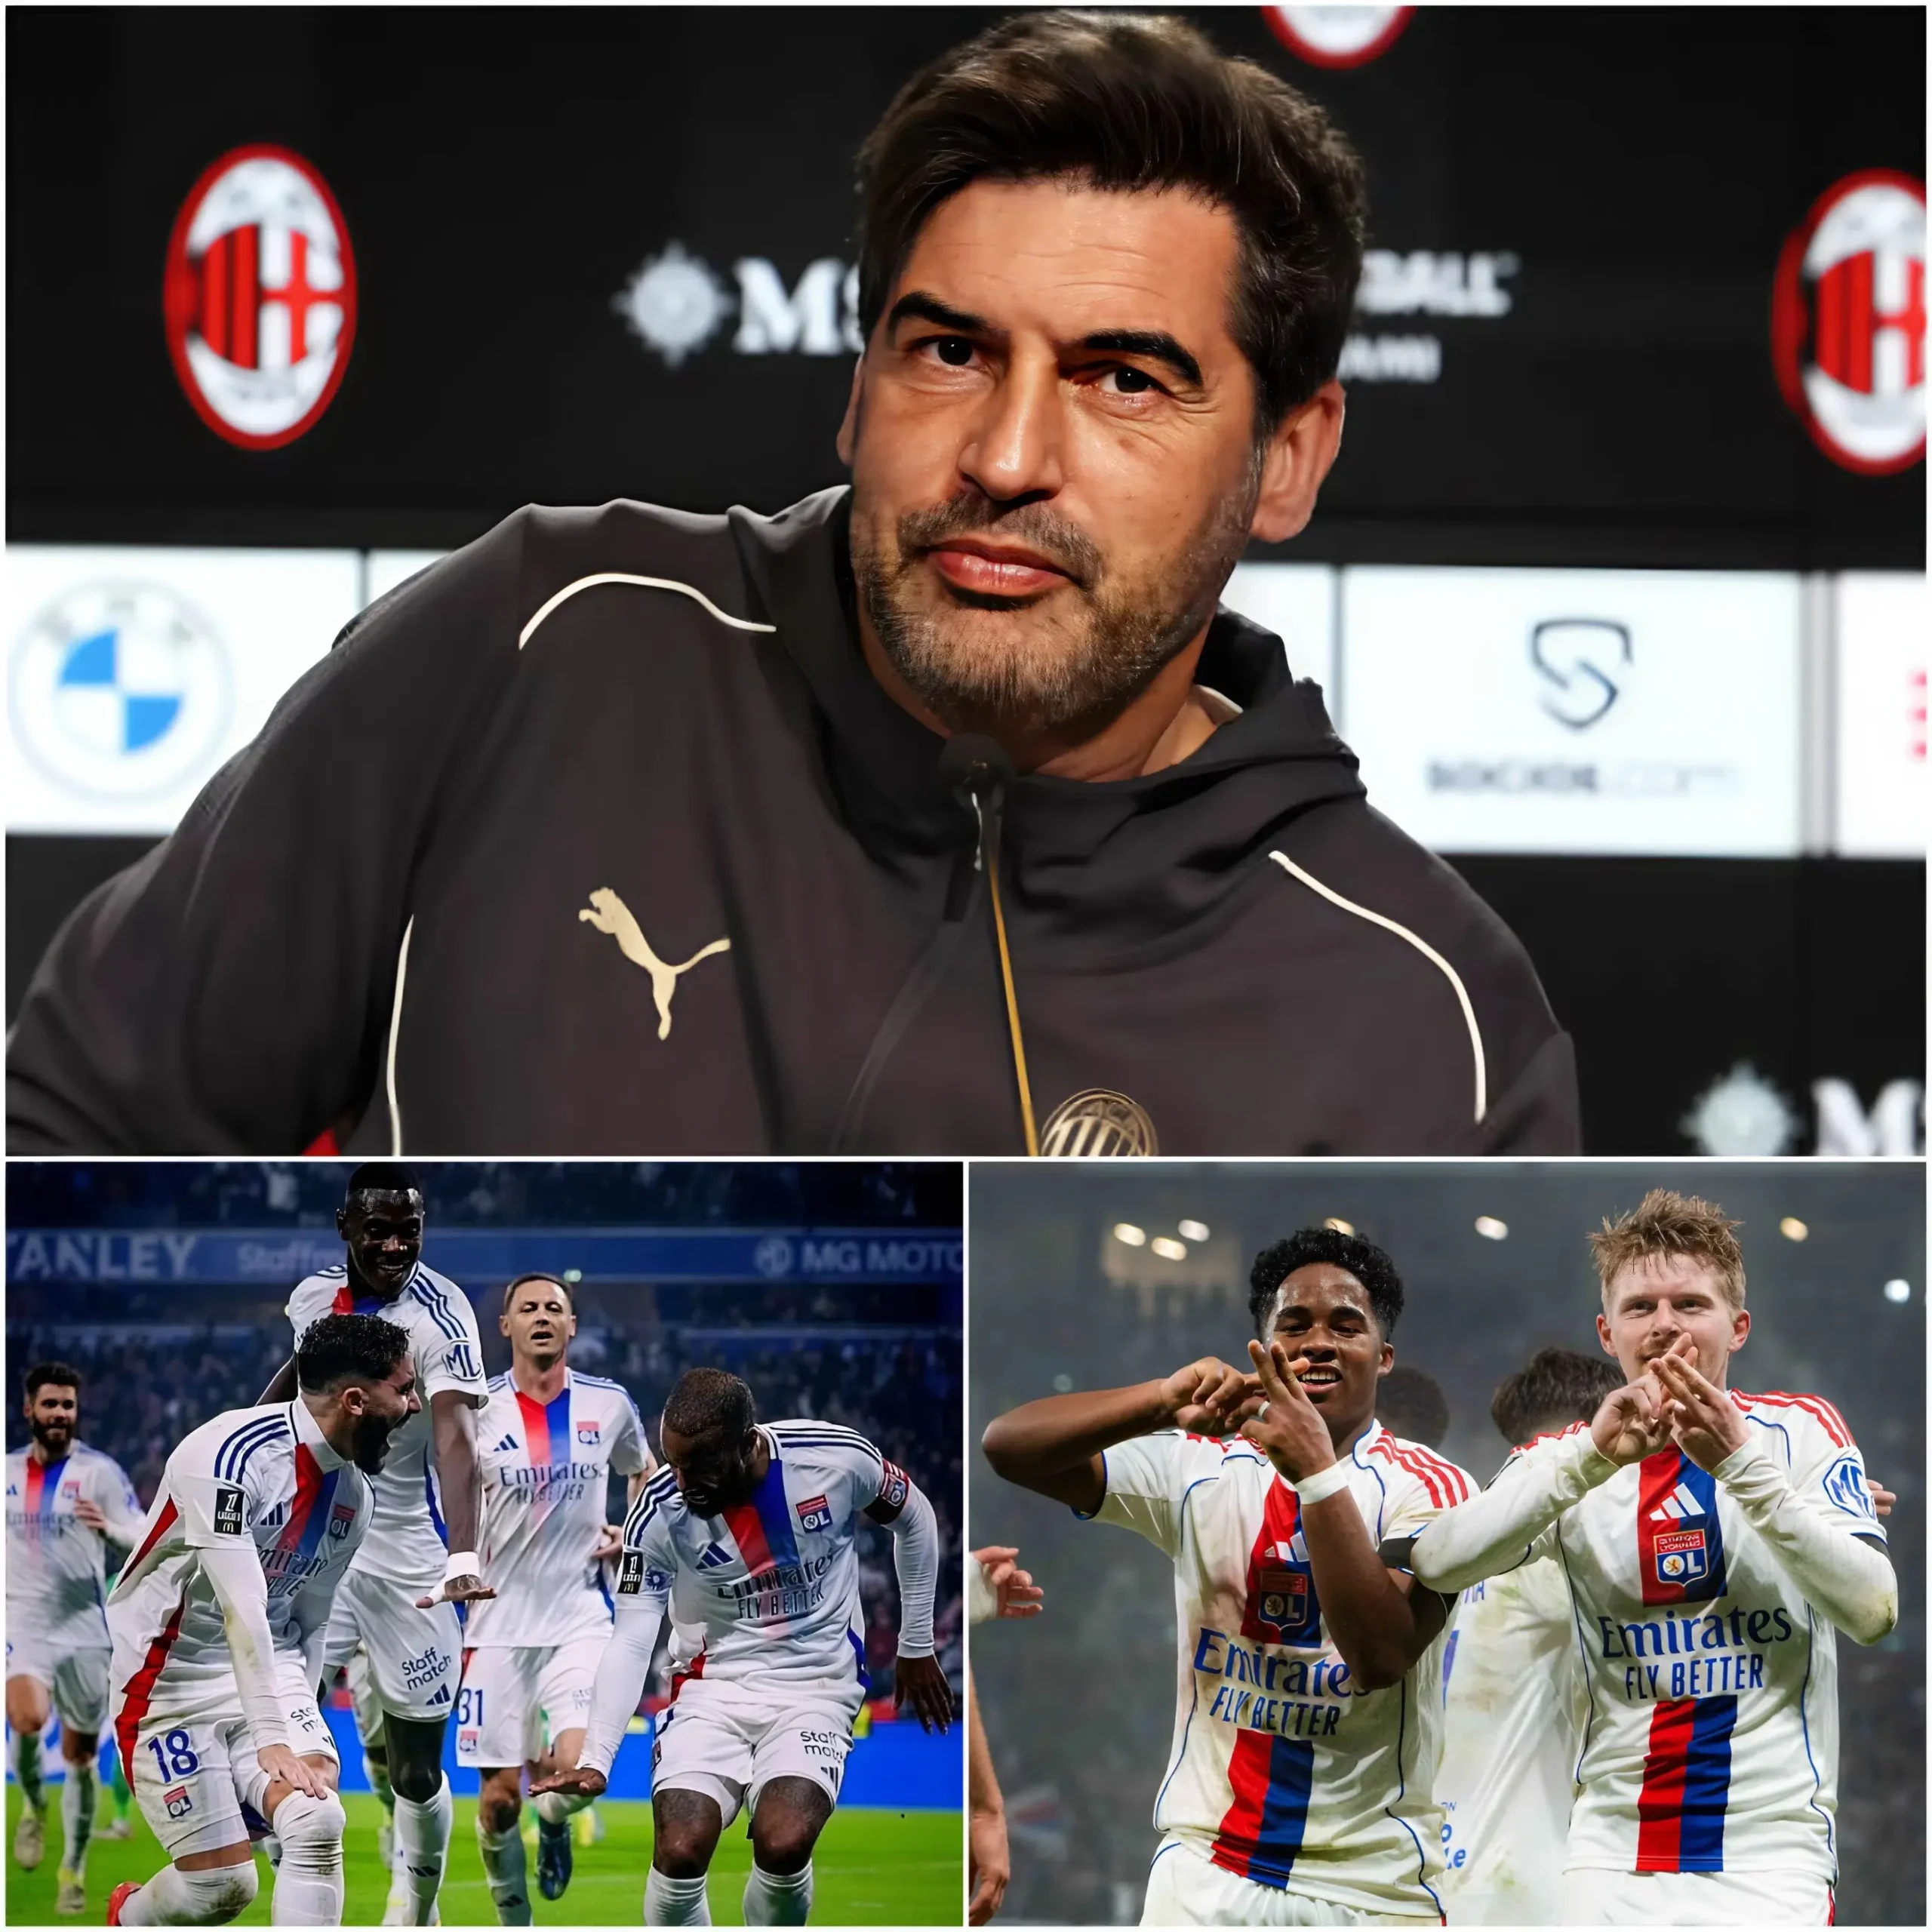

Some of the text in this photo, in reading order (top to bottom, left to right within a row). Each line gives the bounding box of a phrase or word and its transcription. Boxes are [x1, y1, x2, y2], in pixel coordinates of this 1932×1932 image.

[1812, 1075, 1925, 1157] M
[500, 1462, 599, 1487] Emirates
[737, 1578, 824, 1620] FLY BETTER
[1597, 1605, 1792, 1658] Emirates
[401, 1646, 438, 1676] Staff
[406, 1655, 451, 1691] match
[1192, 1627, 1371, 1698] Emirate
[1625, 1654, 1764, 1700] FLY BETTER
[457, 1687, 484, 1727] 31
[1209, 1686, 1341, 1736] FLY BETTER
[148, 1729, 199, 1785] 18
